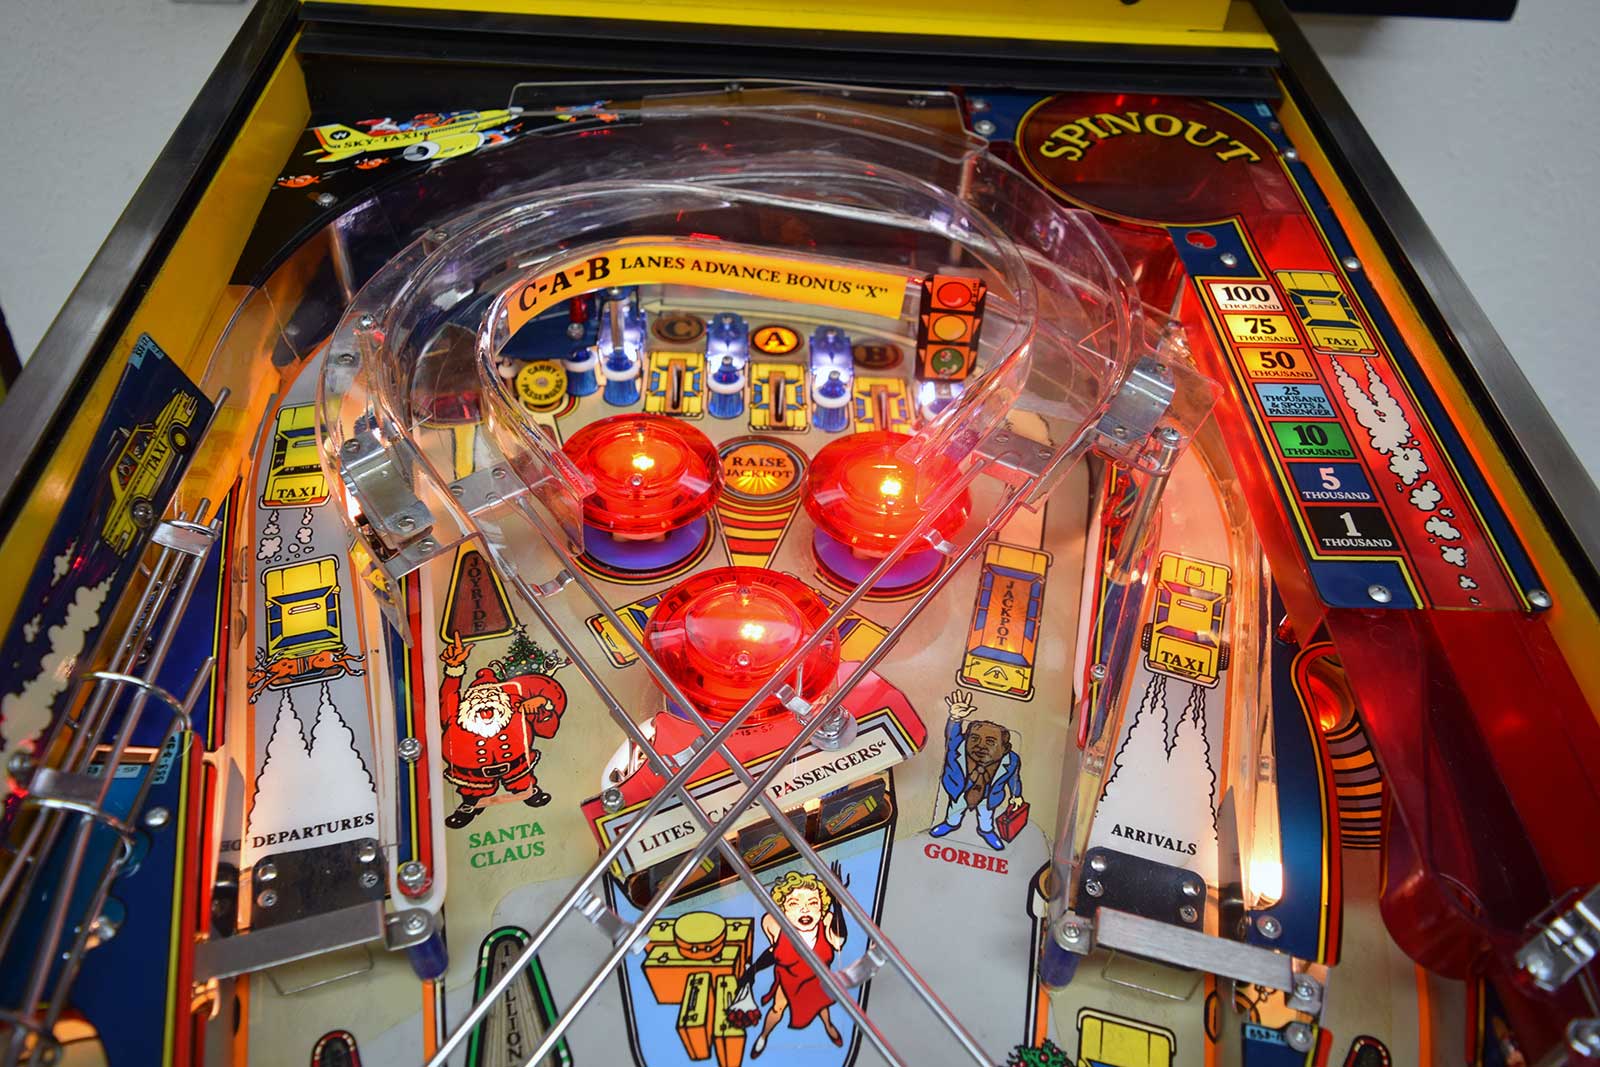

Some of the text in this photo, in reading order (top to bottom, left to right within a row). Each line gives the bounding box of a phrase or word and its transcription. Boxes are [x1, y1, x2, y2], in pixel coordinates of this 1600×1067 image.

[344, 131, 418, 148] SKY-TAXI
[1040, 111, 1261, 164] SPINOUT
[518, 256, 610, 311] C-A-B
[621, 256, 685, 270] LANES
[691, 259, 780, 284] ADVANCE
[786, 273, 852, 294] BONUS
[1222, 286, 1270, 302] 100
[664, 319, 694, 336] C
[1244, 317, 1277, 335] 75
[763, 332, 789, 348] A
[1237, 335, 1297, 343] THOUSAND
[1323, 337, 1358, 347] TAXI
[864, 347, 890, 364] B
[1260, 351, 1296, 369] 50
[528, 365, 556, 375] CARRY
[1251, 370, 1313, 378] THOUSAND
[521, 379, 563, 400] PASSENGERS
[1282, 386, 1300, 395] 25
[1263, 395, 1326, 403] THOUSAND
[1268, 408, 1331, 416] PASSENGER
[1292, 425, 1328, 446] 10
[146, 439, 168, 471] TAXI
[1285, 447, 1351, 457] THOUSAND
[732, 456, 787, 468] RAISE
[725, 467, 793, 478] JACKPOT
[1319, 467, 1340, 490] 5
[276, 486, 317, 499] TAXI
[1302, 491, 1370, 500] THOUSAND
[1339, 512, 1361, 537] 1
[1322, 538, 1393, 548] THOUSAND
[467, 556, 487, 632] JOYRIDE
[997, 581, 1014, 645] JACKPOT
[1160, 651, 1205, 674] TAXI
[252, 812, 375, 849] DEPARTURES
[469, 821, 545, 849] SANTA
[638, 820, 695, 853] LITES
[1111, 823, 1197, 856] ARRIVALS
[470, 841, 545, 869] CLAUS
[924, 844, 1009, 874] GORBIE
